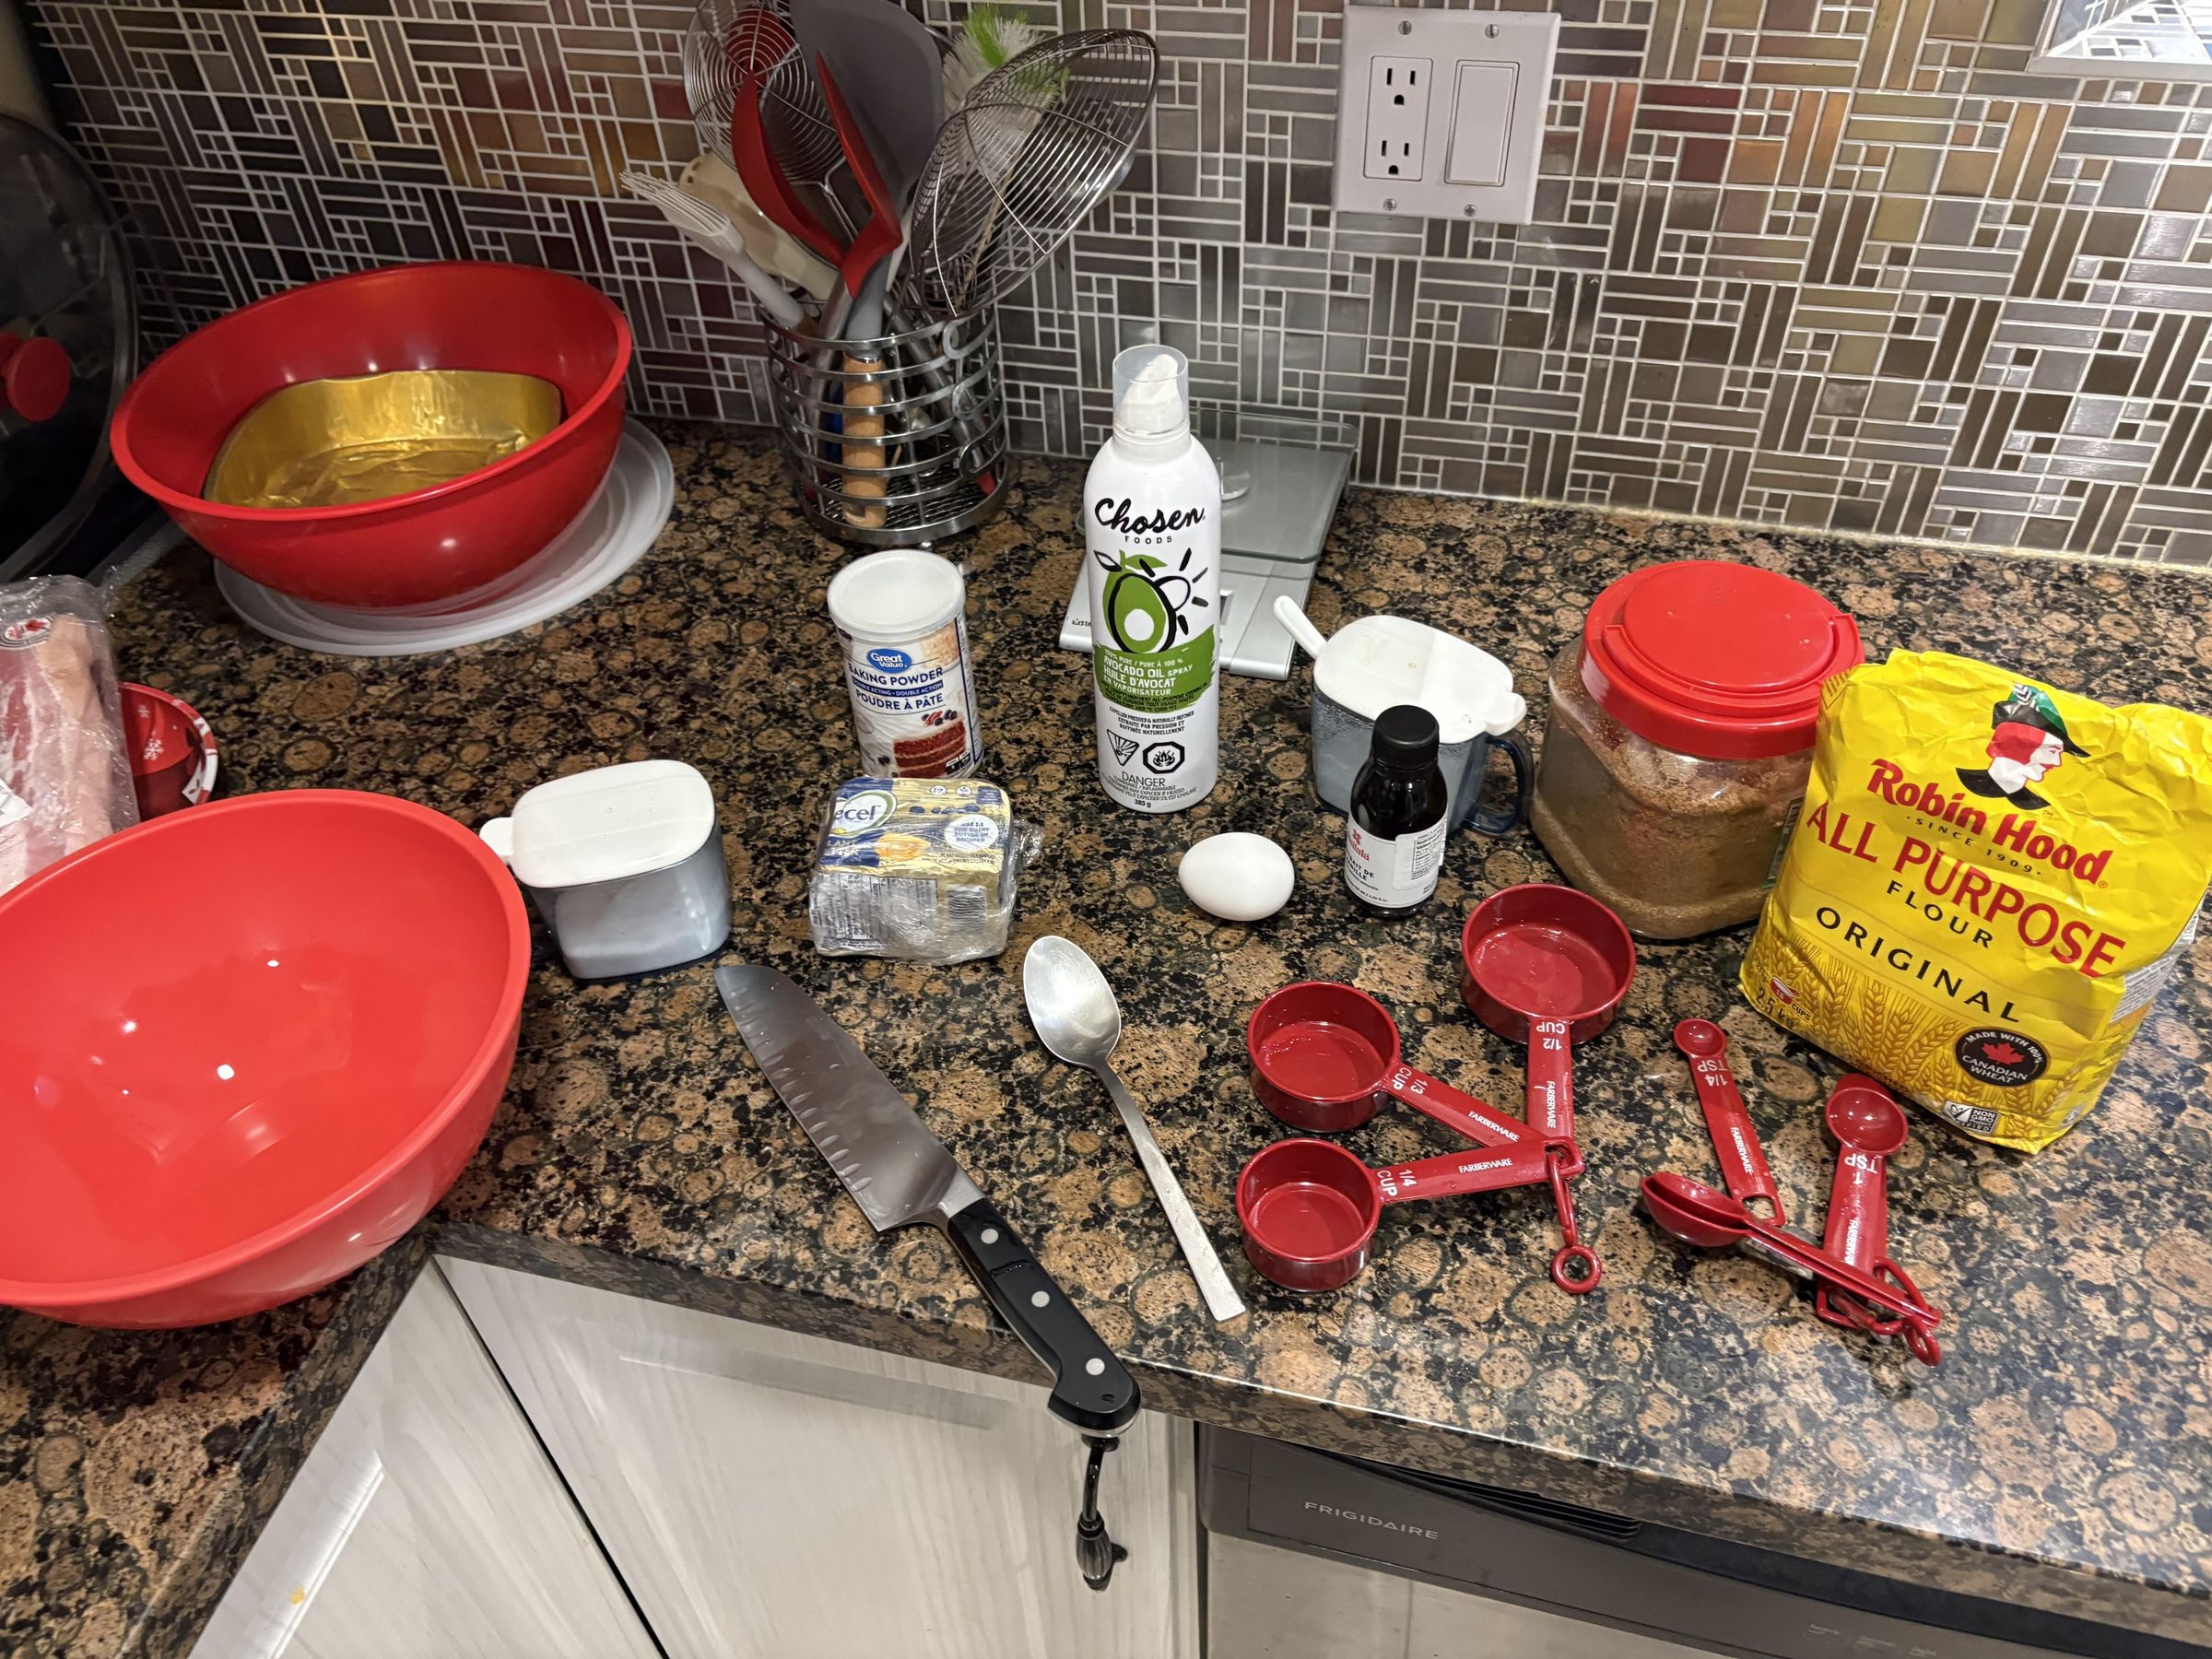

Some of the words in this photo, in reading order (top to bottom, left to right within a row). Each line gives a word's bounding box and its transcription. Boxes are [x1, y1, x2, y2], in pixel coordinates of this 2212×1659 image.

[1094, 498, 1205, 535] Chosen
[1124, 535, 1172, 545] FOODS
[870, 653, 903, 663] Great
[1104, 654, 1144, 677] AVOCADO
[1147, 668, 1165, 678] OIL
[1168, 664, 1194, 677] SPRAY
[848, 663, 887, 685] BAKING
[890, 666, 943, 686] POWDER
[1104, 665, 1127, 684] HUILE
[1129, 677, 1176, 688] D'AVOCAT
[871, 687, 891, 696] ACTING
[922, 682, 942, 693] ACTION
[1112, 682, 1171, 696] VAPORISATEUR
[855, 688, 900, 711] POUDRE
[904, 699, 912, 711] À
[916, 693, 944, 709] PÂTE
[1122, 771, 1166, 787] DANGER
[834, 806, 877, 820] ecel
[1865, 758, 1990, 836] Robin
[1992, 812, 2112, 887] Hood
[1914, 817, 1973, 847] SINCE
[1984, 847, 2033, 875] 1909
[1363, 869, 1374, 878] DE
[1806, 800, 1878, 864] ALL
[1893, 836, 2127, 979] PURPOSE
[1886, 880, 1994, 950] FLOUR
[1816, 906, 2020, 1024] ORIGINAL
[1791, 1003, 1811, 1021] CUPS
[1535, 1021, 1566, 1035] CUP
[1542, 1038, 1563, 1052] 1/2
[1965, 1031, 1997, 1043] MADE
[1999, 1032, 2030, 1047] WITH
[2028, 1046, 2043, 1064] 100%
[1697, 1059, 1727, 1073] TSP
[1962, 1054, 2029, 1080] CANADIAN
[1970, 1065, 2015, 1084] WHEAT
[1392, 1066, 1413, 1091] CUP
[1409, 1078, 1429, 1095] 1/3
[1704, 1074, 1728, 1087] 1/4
[1547, 1080, 1556, 1129] FARBERWARE
[1972, 1109, 1996, 1118] NON
[1467, 1110, 1521, 1143] FARBERWARE
[1971, 1114, 1994, 1123] GMO
[1730, 1126, 1754, 1175] FARBERWARE
[1458, 1158, 1513, 1173] FARBERWARE
[1844, 1152, 1877, 1174] TSP
[1376, 1170, 1398, 1197] CUP
[1398, 1169, 1418, 1188] 1/4
[1853, 1171, 1864, 1185] 1
[1304, 1501, 1439, 1540] FRIGIDAIRE
